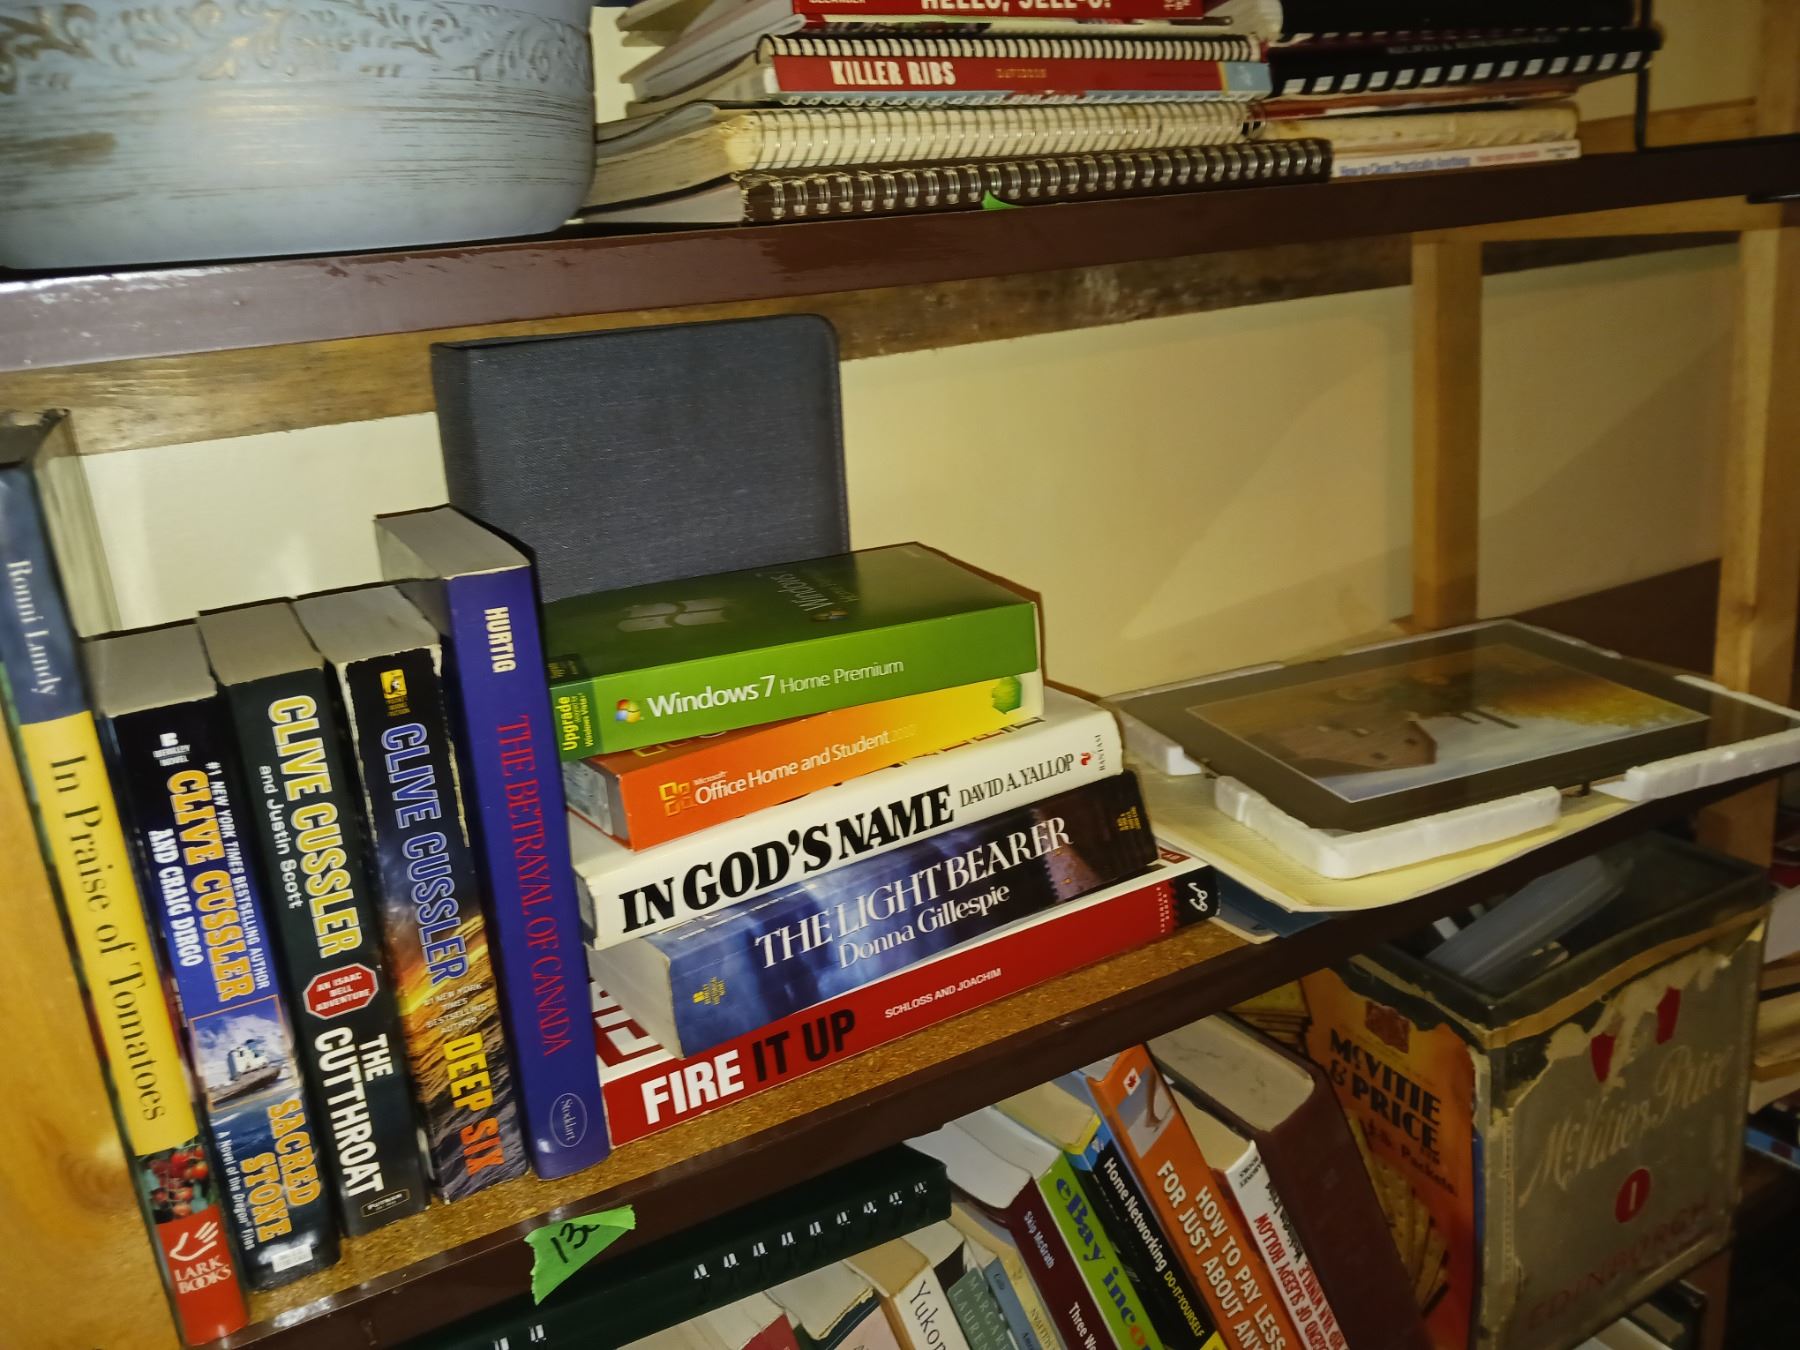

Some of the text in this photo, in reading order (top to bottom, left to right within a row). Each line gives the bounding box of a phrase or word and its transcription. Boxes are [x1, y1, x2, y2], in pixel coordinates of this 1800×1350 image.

[830, 61, 956, 85] KILLER RIBS
[484, 606, 516, 674] HURTIG
[560, 696, 582, 751] Upgrade
[648, 658, 904, 720] Windows 7 Home Premium
[211, 780, 229, 806] NEW
[381, 721, 438, 829] CLIVE
[694, 777, 747, 805] Office
[748, 764, 797, 790] Home
[800, 751, 831, 777] and
[831, 731, 889, 767] Student
[958, 753, 1075, 808] DAVID A. YALLOP
[217, 806, 236, 839] YORK
[258, 765, 303, 909] and Justin Scott
[268, 694, 362, 959] CLIVE CUSSLER
[166, 769, 257, 1002] CLIVE CUSSLER
[225, 840, 245, 876] TIMES
[496, 714, 573, 1057] THE BETRAYAL OF CANADA
[618, 877, 674, 933] IN
[682, 826, 830, 902] GOD'S
[836, 784, 955, 858] NAME
[755, 911, 832, 969] THE
[831, 875, 940, 939] LIGHT
[938, 816, 1074, 890] BEARER
[147, 828, 204, 967] AND CRAIG DIRGO
[234, 876, 260, 946] BESTSELLING
[402, 830, 468, 985] CUSSLER
[838, 882, 1010, 969] Donna Gillespie
[50, 754, 167, 1123] In Praise of Tomatoes
[249, 946, 271, 990] AUTHOR
[885, 967, 1002, 1019] SCHLOSS AND JOACHIM
[359, 1033, 393, 1082] THE
[641, 1008, 855, 1125] FIRE IT UP
[217, 1131, 231, 1140] A
[314, 1027, 384, 1197] CUTTHROAT
[443, 1032, 505, 1177] DEEP SIX
[1352, 1072, 1440, 1156] PRICE
[222, 1139, 236, 1161] Novel
[226, 1163, 239, 1176] of
[230, 1176, 242, 1191] the
[267, 1098, 321, 1206] SACRED
[240, 1152, 292, 1243] STONE
[1056, 1178, 1106, 1261] eBay
[173, 1255, 224, 1282] LARK
[238, 1226, 255, 1252] Files
[1024, 1210, 1055, 1269] Skip McGrath
[1103, 1157, 1205, 1338] Home Networking DO-IT-YOURSELF
[1157, 1159, 1187, 1208] FOR
[1178, 1207, 1213, 1255] JUST
[1202, 1256, 1245, 1319] ABOUT
[1195, 1186, 1286, 1350] HOW TO PAY LESS
[1254, 1212, 1287, 1265] HOLLOW
[177, 1264, 232, 1294] BOOKS
[1277, 1262, 1306, 1306] SLEEPY
[1069, 1302, 1088, 1338] Three
[1296, 1306, 1313, 1322] OF
